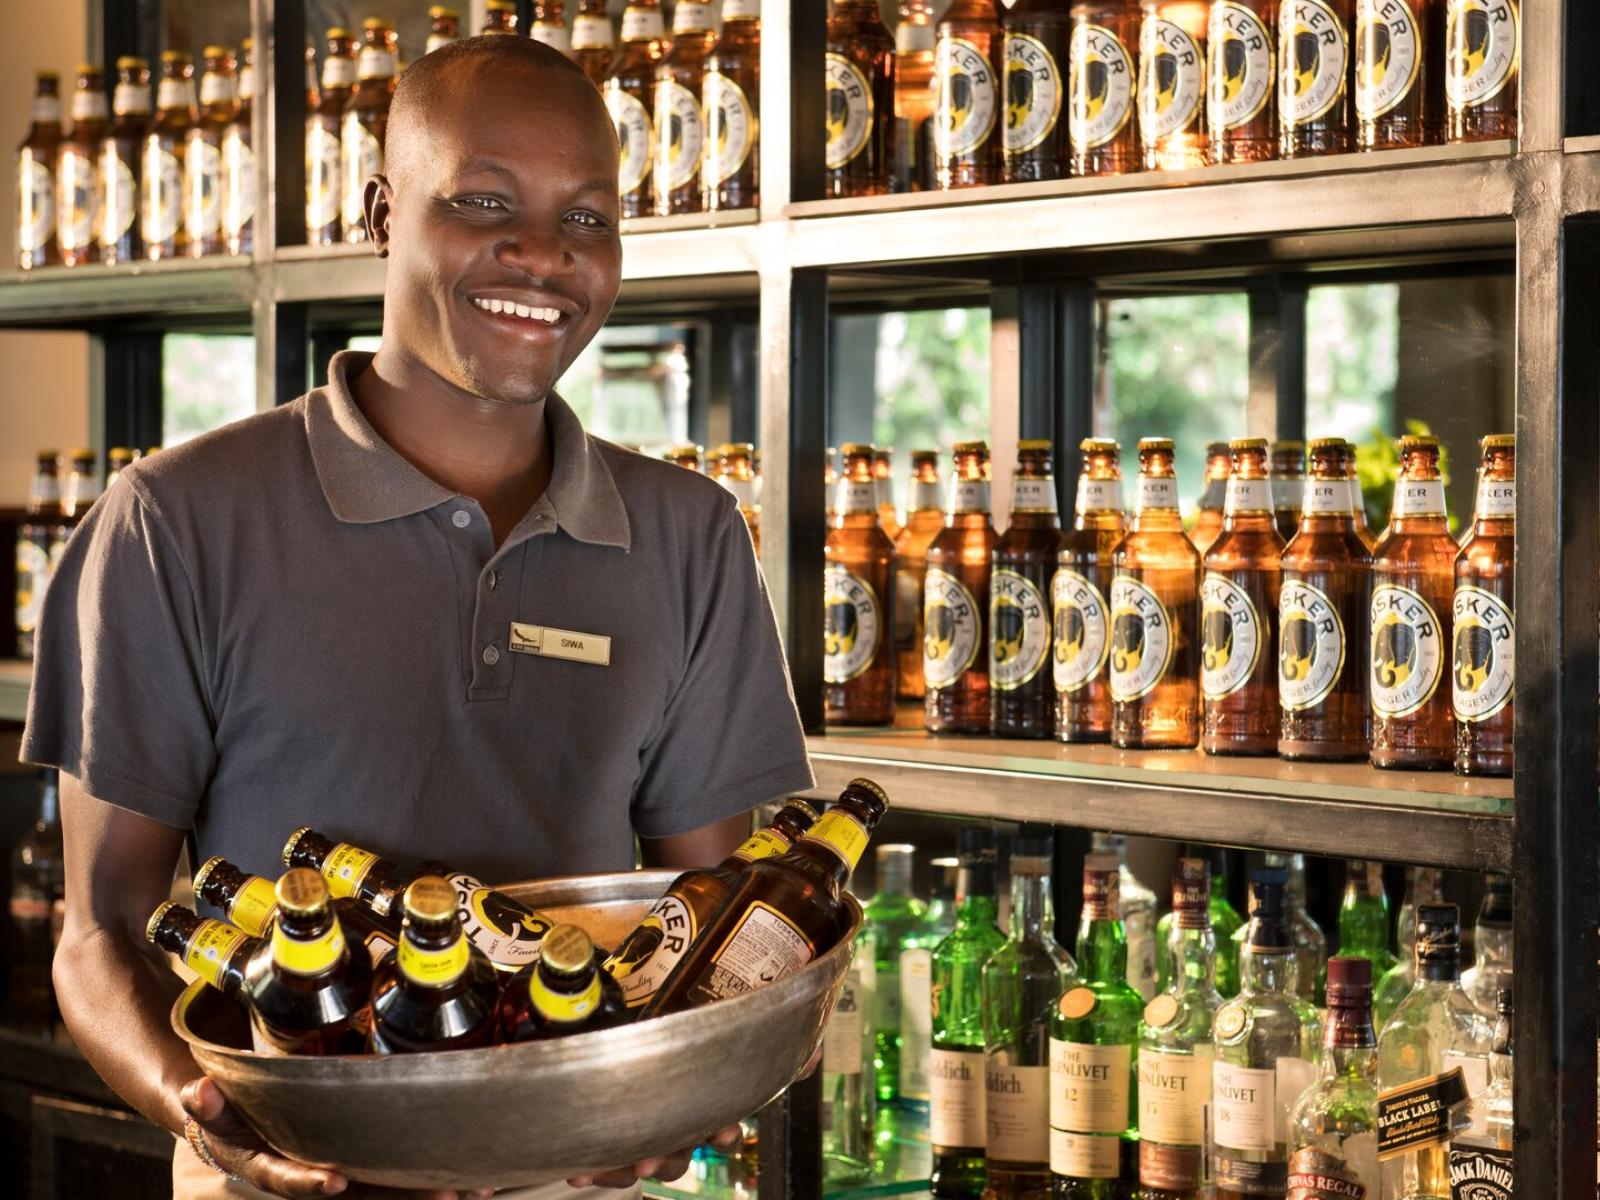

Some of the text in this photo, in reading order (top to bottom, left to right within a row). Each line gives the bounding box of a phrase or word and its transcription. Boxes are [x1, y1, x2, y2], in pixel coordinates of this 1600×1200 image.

[773, 918, 802, 945] TUSKER
[1377, 1109, 1411, 1129] BLACK
[1411, 1099, 1446, 1118] LABEL
[1316, 1175, 1361, 1199] REGAL
[1449, 1162, 1476, 1187] JACK
